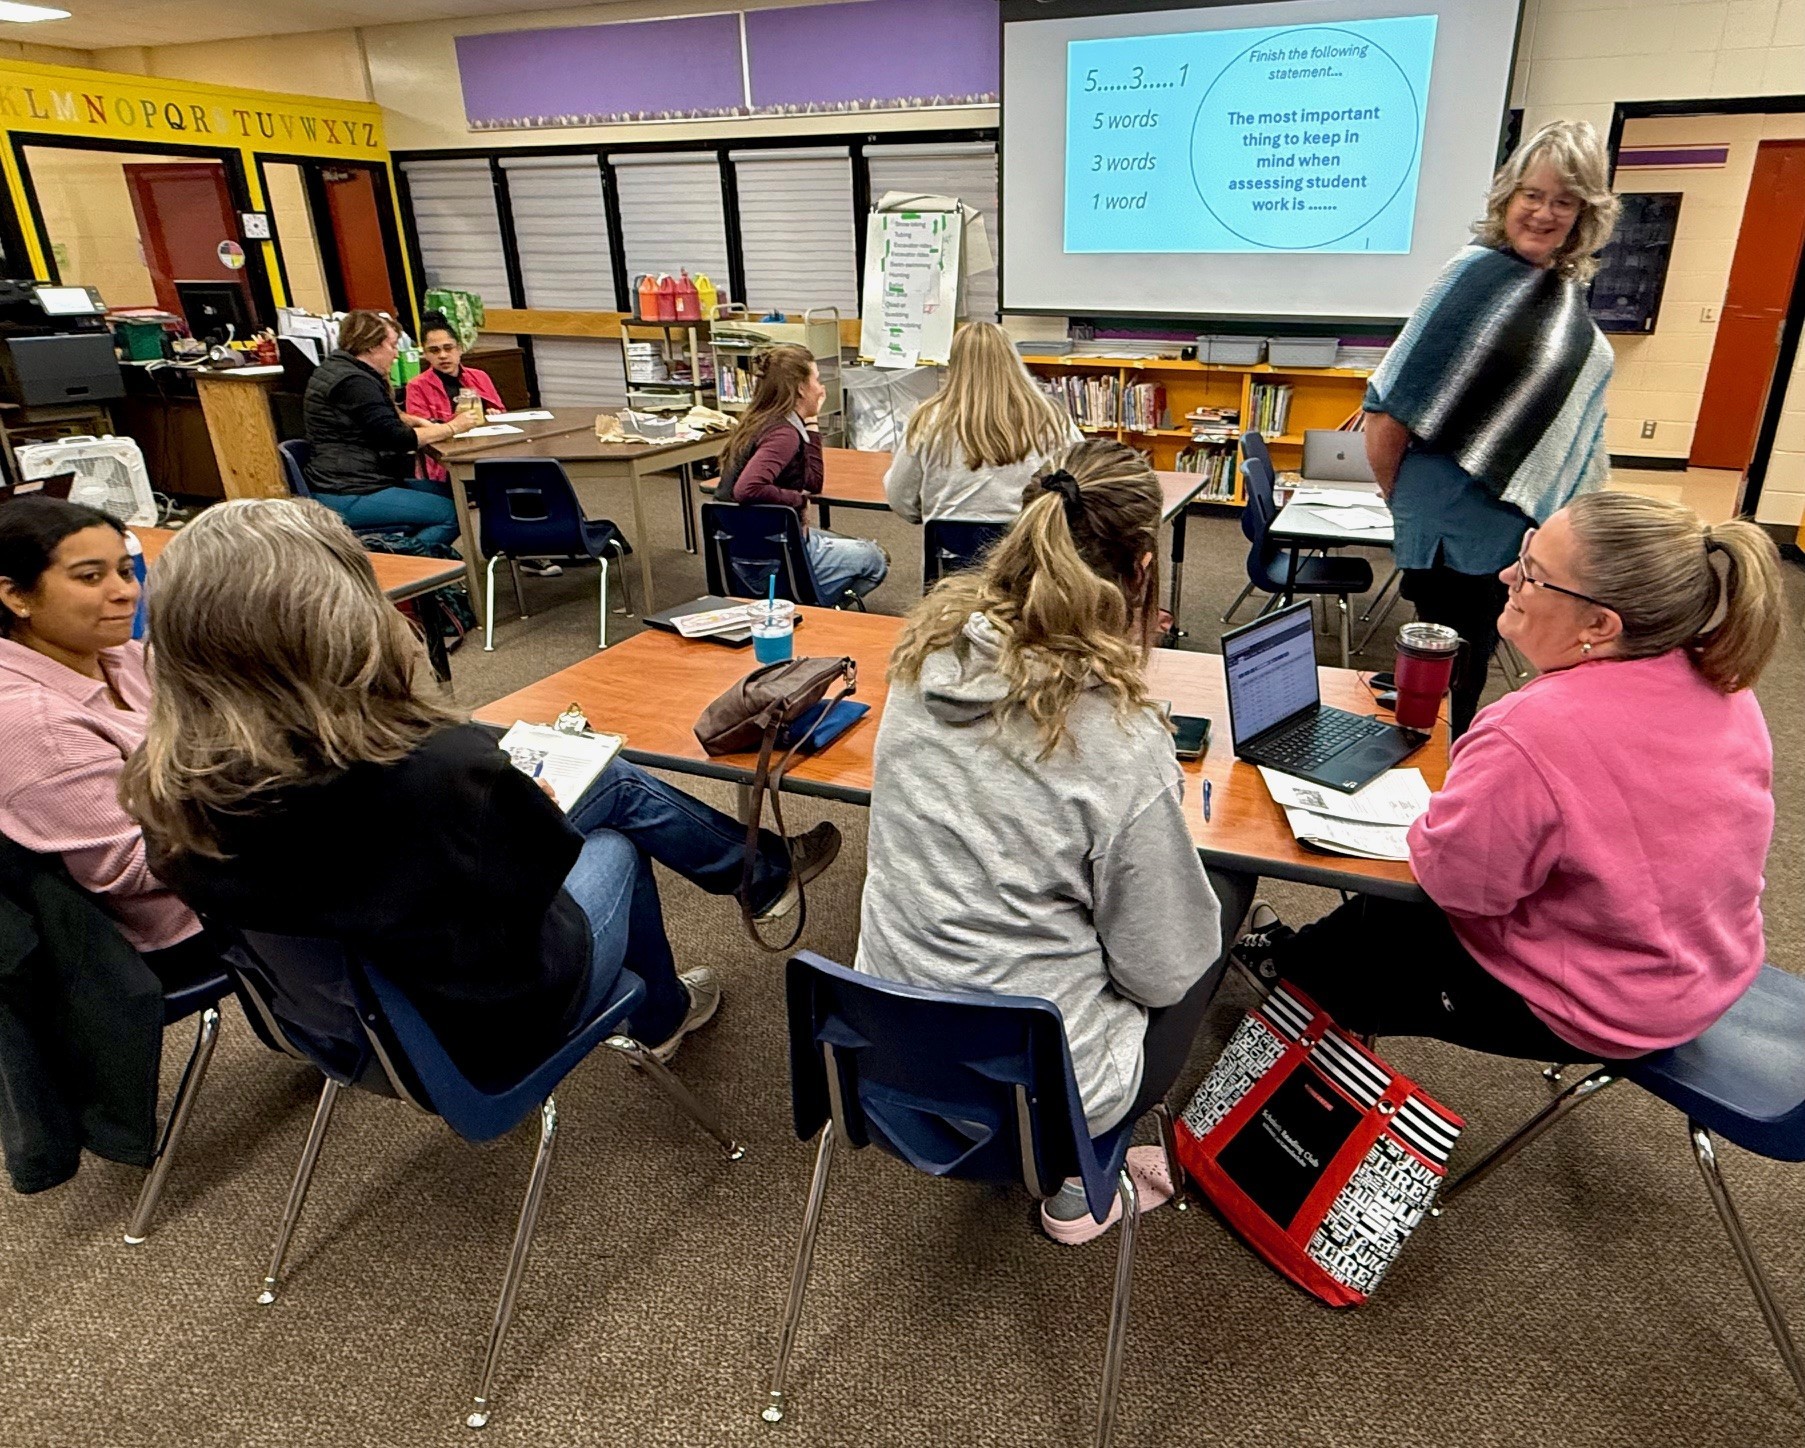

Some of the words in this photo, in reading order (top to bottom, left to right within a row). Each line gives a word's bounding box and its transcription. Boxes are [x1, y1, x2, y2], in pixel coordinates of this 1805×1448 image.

[1249, 49, 1286, 63] Finish
[1288, 48, 1308, 60] the
[1310, 44, 1370, 59] following
[1268, 66, 1343, 80] statement...
[1093, 112, 1105, 130] 5
[1108, 109, 1159, 129] words
[1228, 112, 1255, 125] The
[1258, 110, 1298, 124] most
[1301, 107, 1381, 125] important
[1243, 132, 1281, 149] thing
[1284, 133, 1300, 145] to
[1303, 131, 1341, 147] keep
[1344, 129, 1359, 143] in
[1091, 154, 1103, 172] 3
[1106, 152, 1157, 171] words
[1256, 154, 1295, 168] mind
[1298, 153, 1341, 167] when
[1228, 175, 1304, 192] assessing
[1306, 175, 1367, 189] student
[1092, 193, 1100, 210] 1
[1105, 191, 1148, 210] word
[1252, 197, 1290, 211] work
[1292, 197, 1306, 211] is
[1238, 1019, 1268, 1052] READ
[1371, 1155, 1428, 1202] LIRE
[1353, 1189, 1401, 1244] LIRE
[1340, 1230, 1388, 1275] Lire
[1316, 1239, 1373, 1287] LIRE
